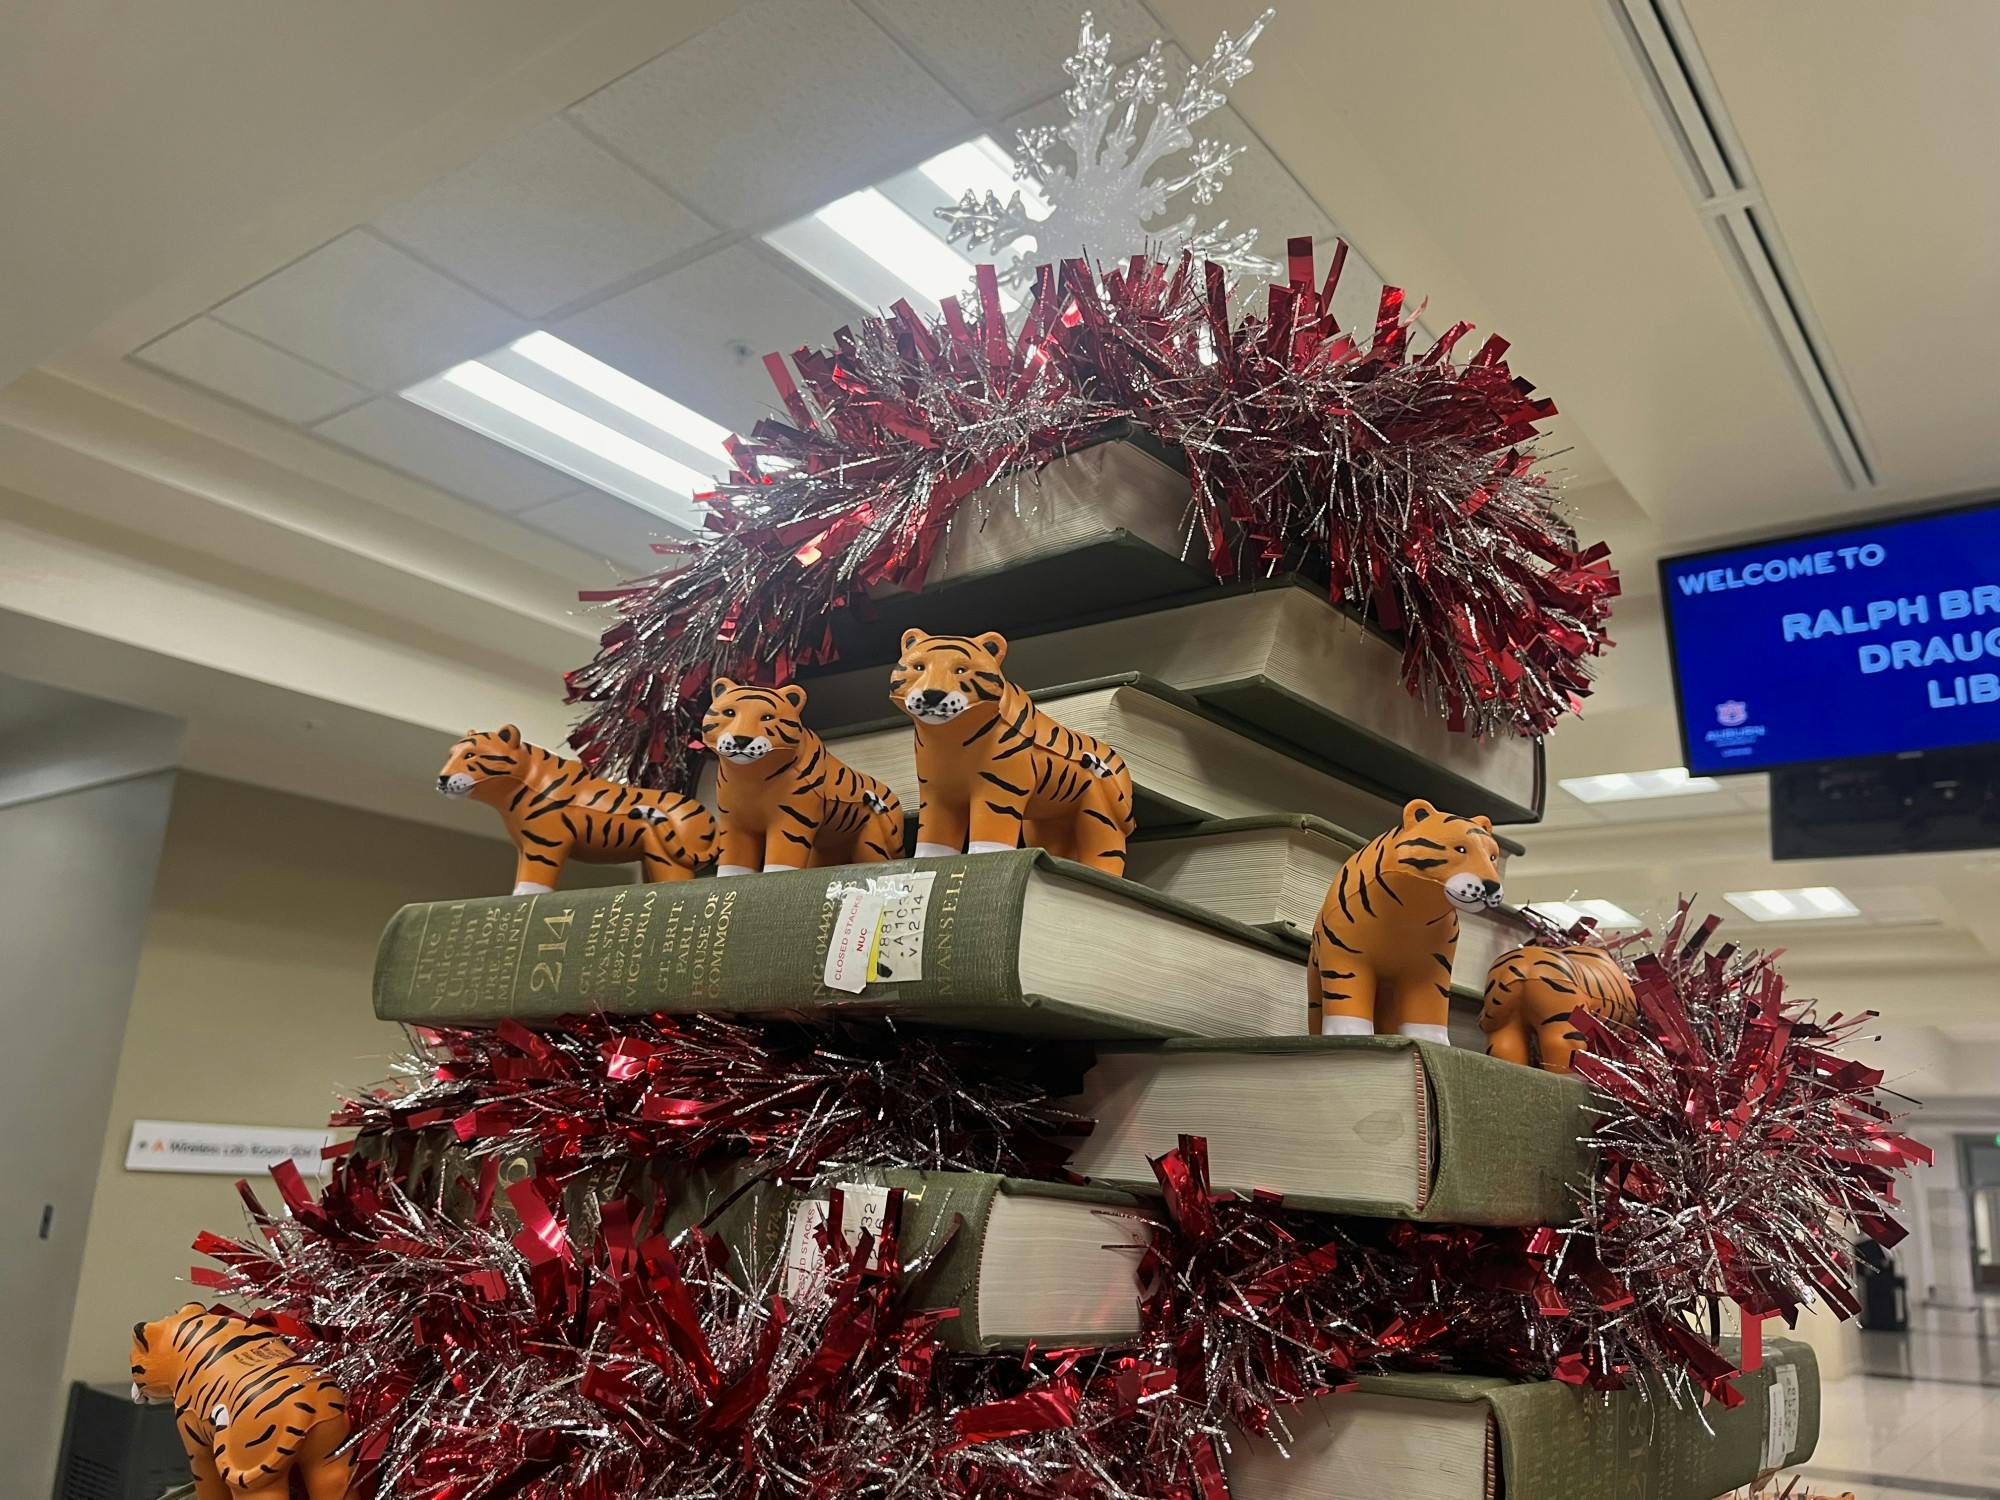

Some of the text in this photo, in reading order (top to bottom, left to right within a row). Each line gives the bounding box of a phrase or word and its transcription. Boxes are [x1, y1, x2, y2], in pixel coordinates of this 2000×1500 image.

[1678, 543, 1886, 596] WELCOME TO
[1782, 595, 1929, 642] RALPH
[530, 908, 576, 993] 214
[585, 906, 606, 957] BRIT.
[603, 889, 628, 949] STATS.
[662, 900, 685, 953] BRIT.
[691, 891, 721, 998] HOUSE OF
[708, 890, 738, 999] COMMONS
[834, 937, 849, 981] CLOSED
[845, 895, 864, 935] STACKS
[856, 927, 868, 953] NUC
[937, 864, 967, 995] MANSELL
[447, 919, 479, 998] Union
[461, 907, 502, 1009] Catalog
[800, 1208, 816, 1254] STACKS
